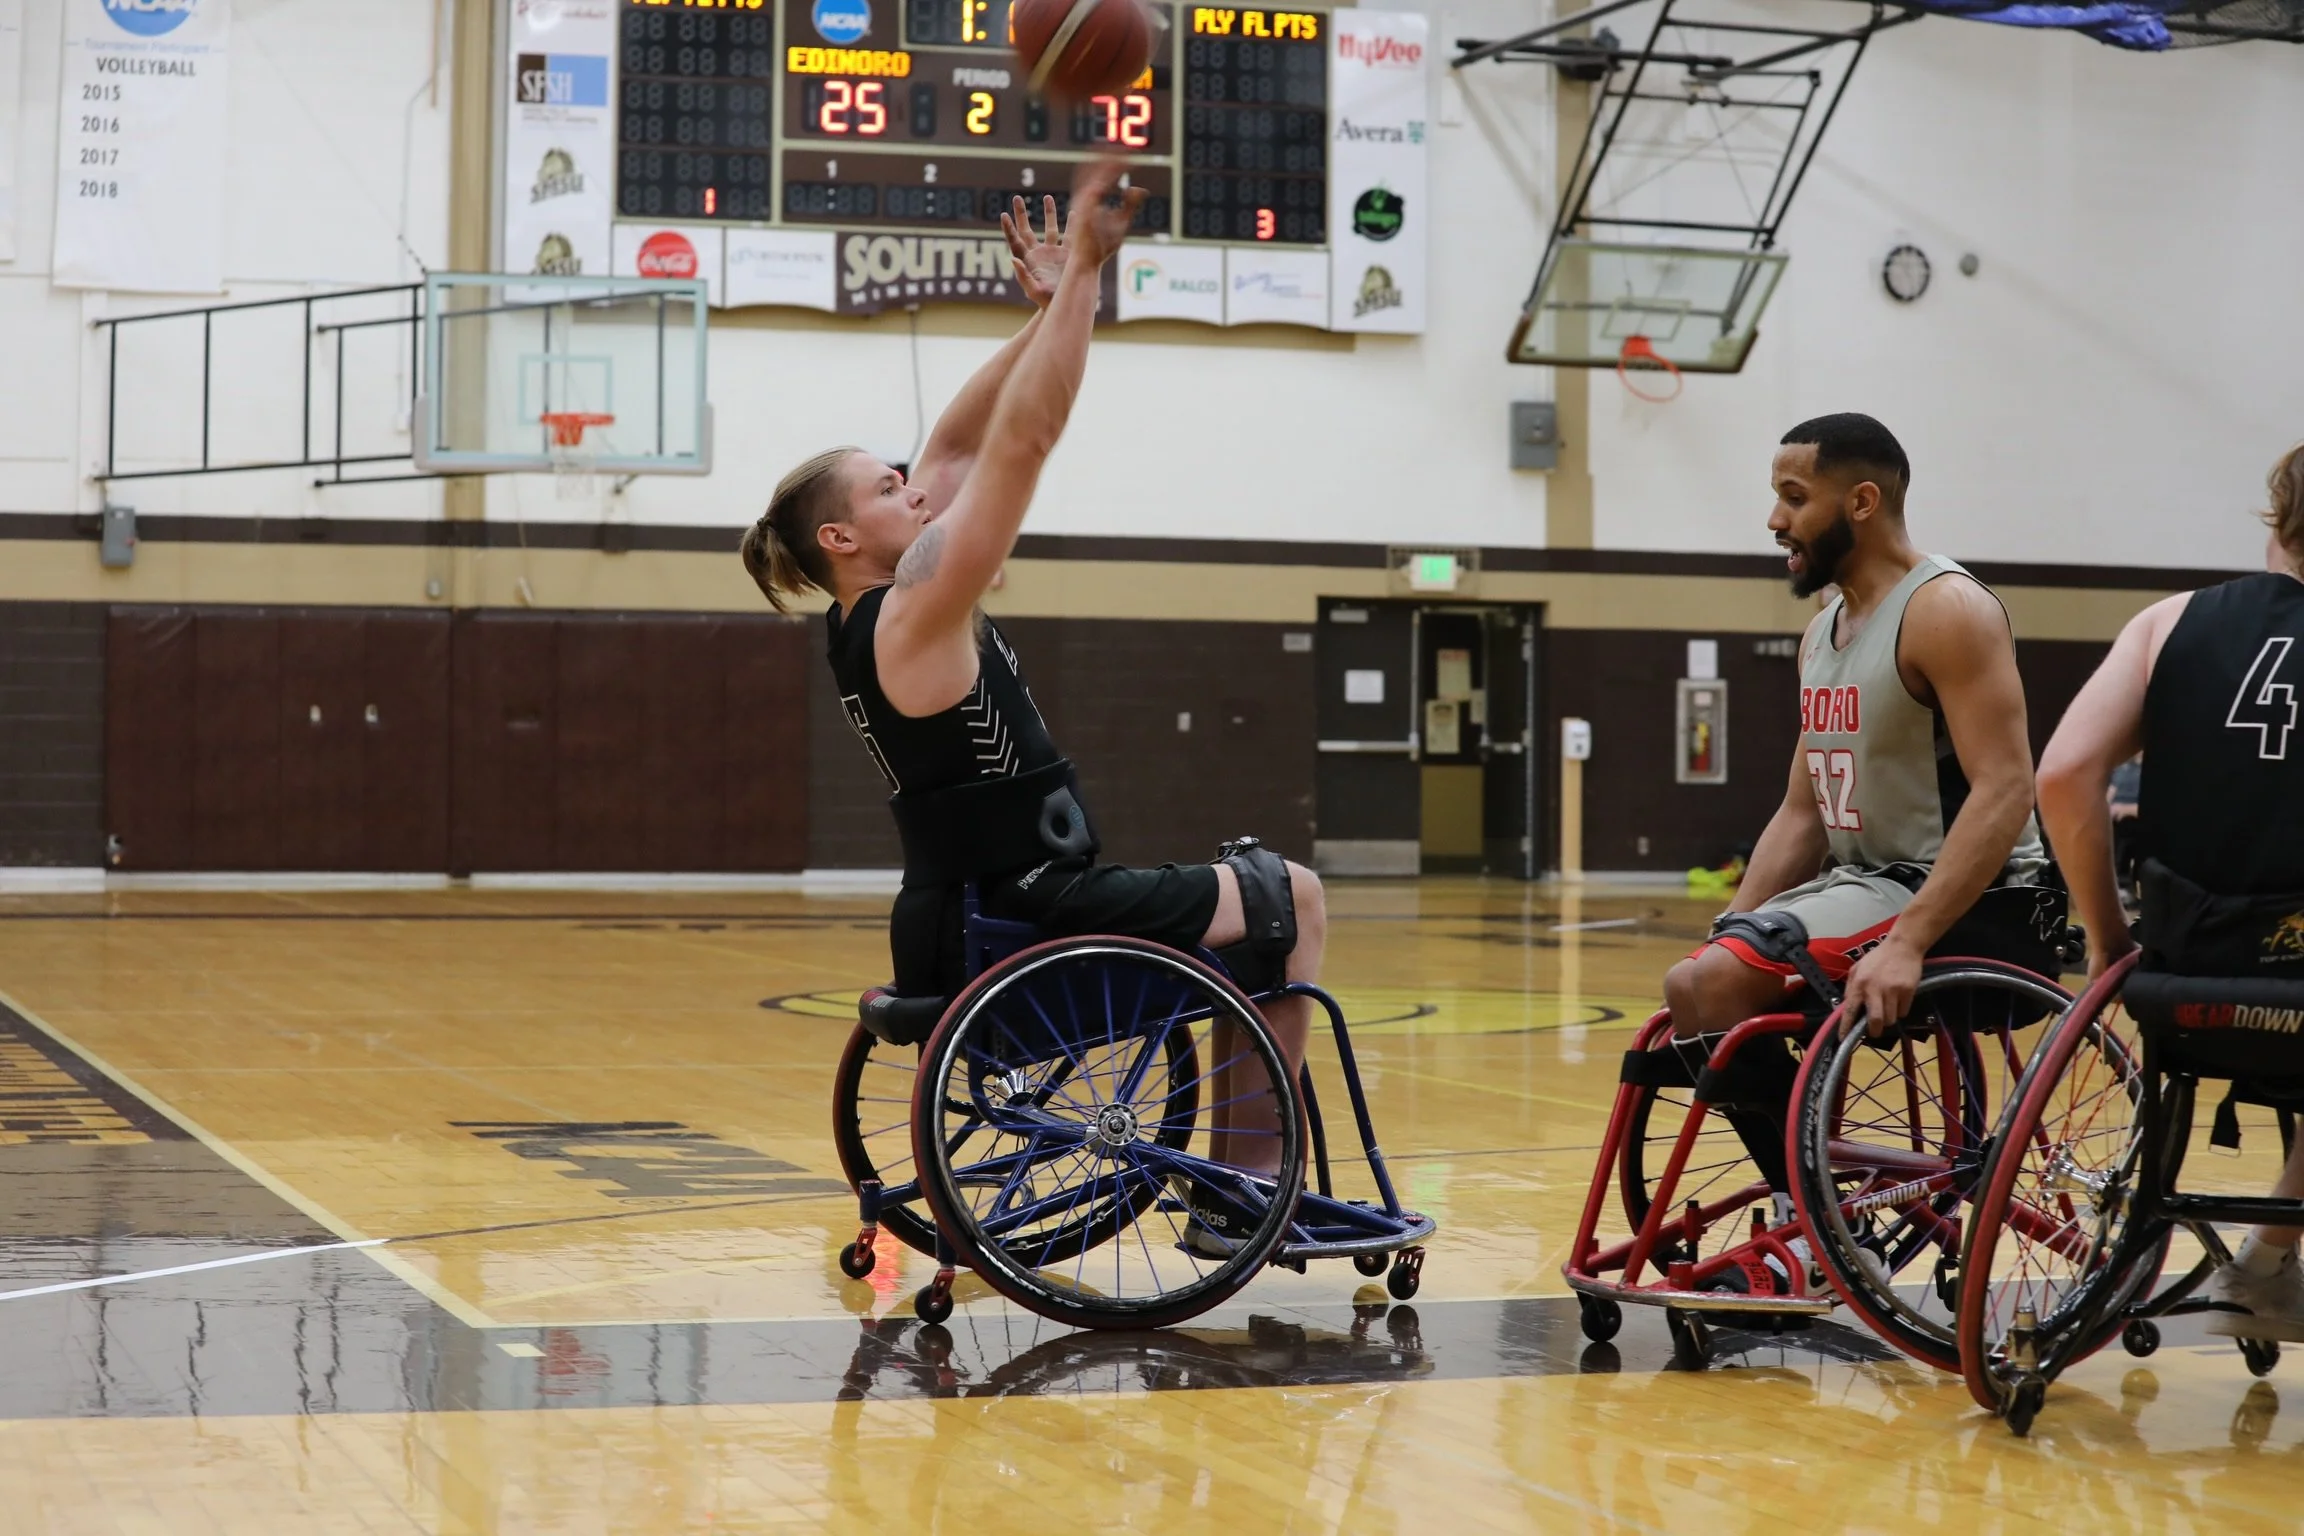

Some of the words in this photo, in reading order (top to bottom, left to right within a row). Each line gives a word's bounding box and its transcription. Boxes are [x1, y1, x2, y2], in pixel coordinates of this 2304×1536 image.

[1243, 11, 1271, 36] FL
[1274, 13, 1317, 39] PTS
[96, 57, 197, 76] VOLLEYBALL
[82, 84, 121, 101] 2015
[820, 80, 886, 134] 25
[966, 91, 995, 134] 2
[1091, 95, 1152, 146] 72
[81, 115, 120, 134] 2016
[1336, 118, 1404, 143] Avera
[79, 148, 119, 166] 2017
[826, 160, 838, 179] 1
[923, 164, 938, 183] 2
[1021, 168, 1035, 188] 3
[1118, 172, 1131, 189] 4
[79, 180, 119, 198] 2018
[704, 187, 716, 215] 1
[1256, 208, 1275, 240] 3
[1169, 278, 1219, 293] RALCO
[2225, 637, 2298, 760] 4
[1806, 748, 1863, 832] 32
